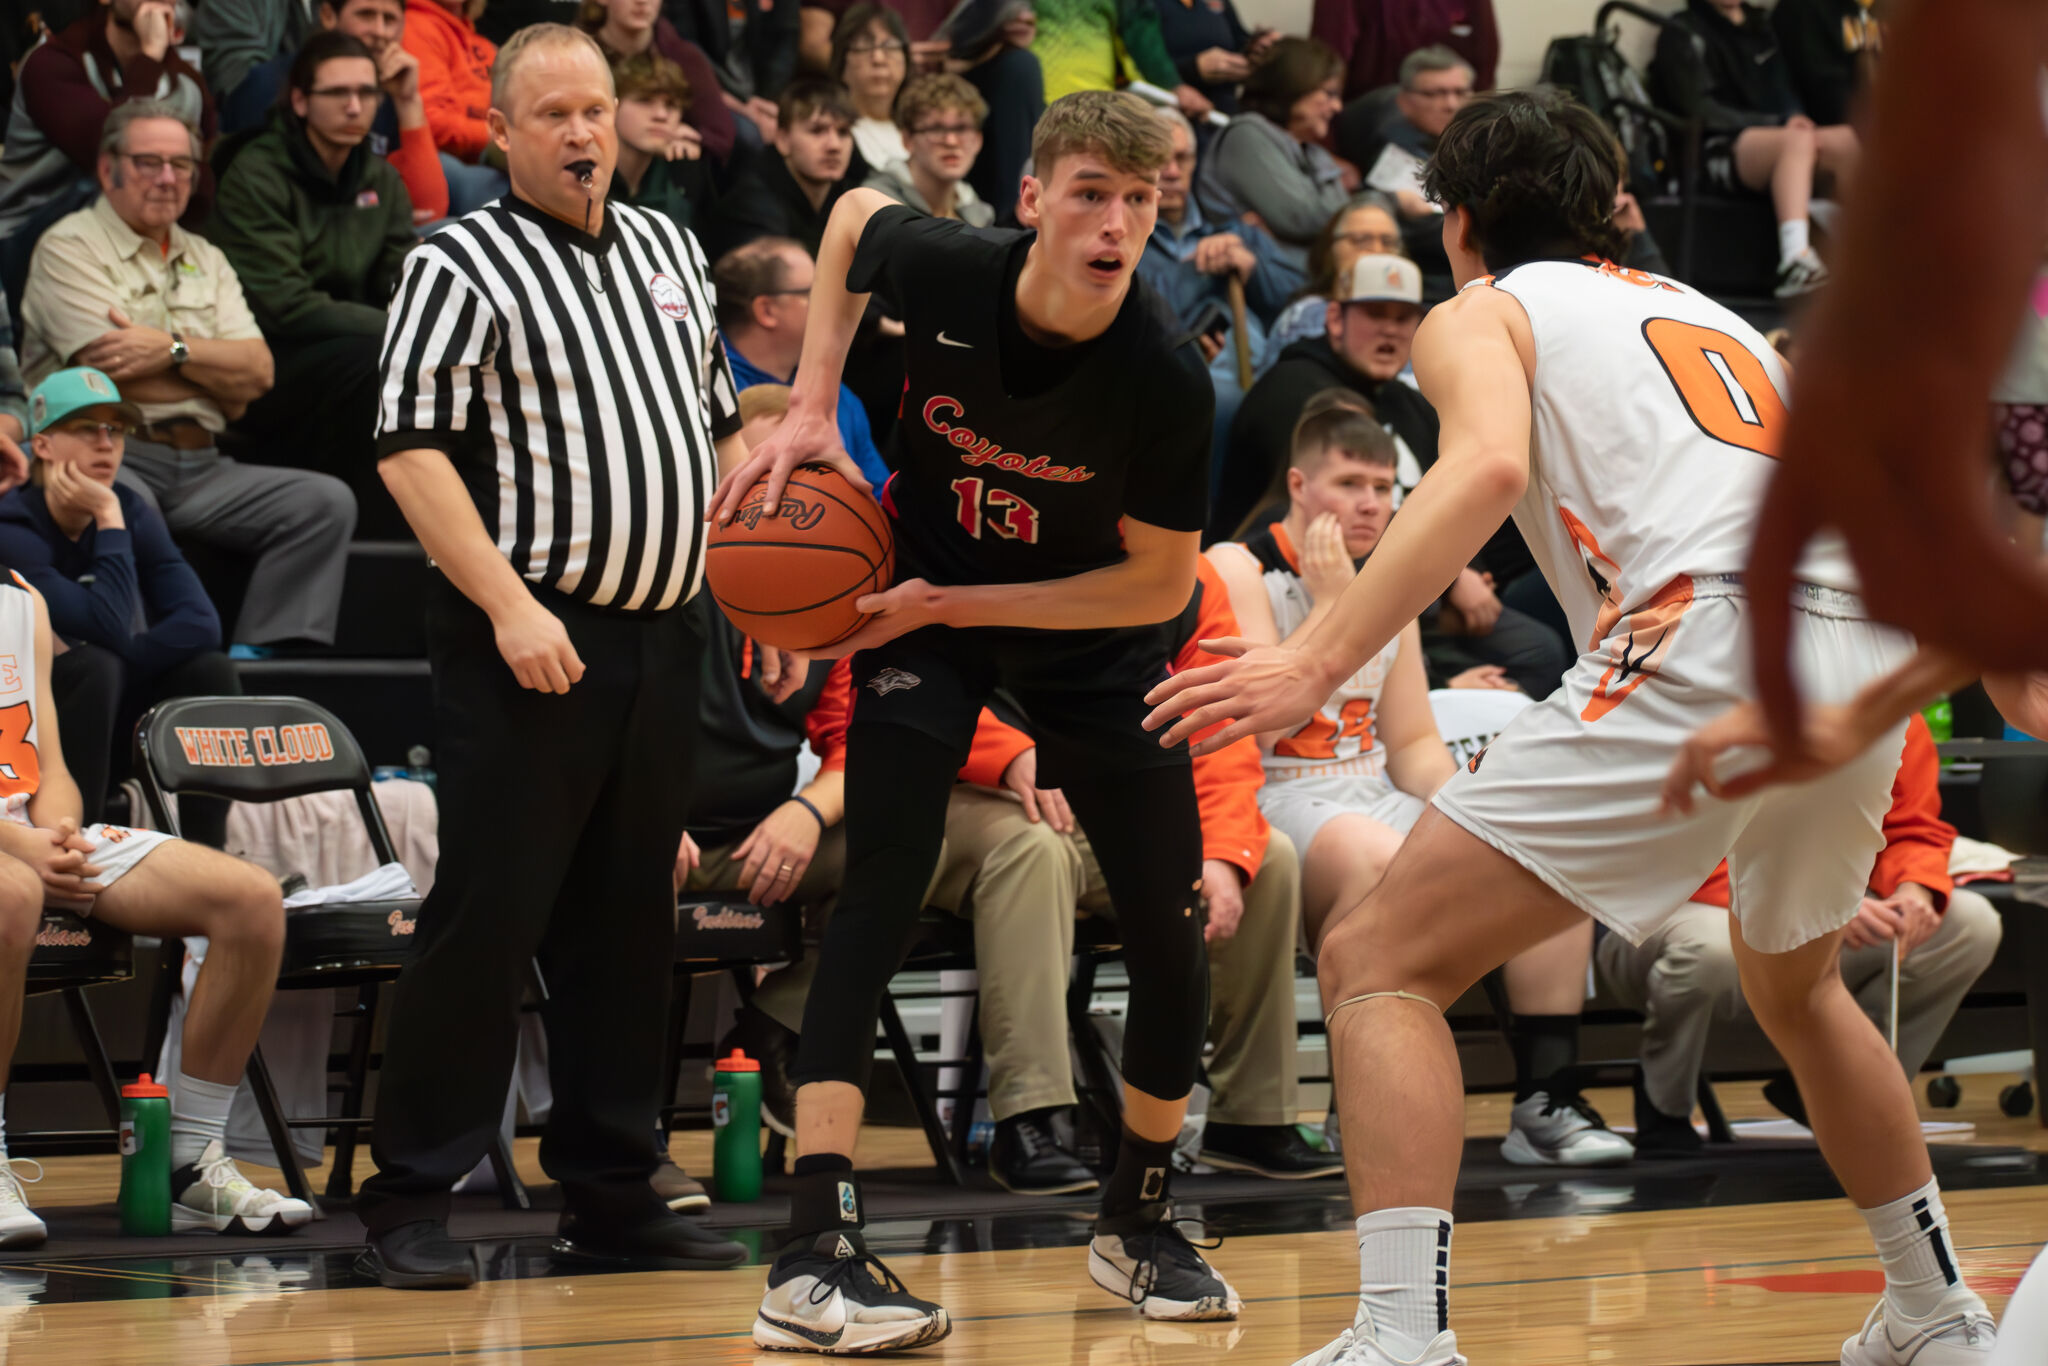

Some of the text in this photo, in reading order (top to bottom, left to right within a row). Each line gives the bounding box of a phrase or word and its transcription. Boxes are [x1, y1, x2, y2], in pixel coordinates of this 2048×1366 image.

[1640, 316, 1786, 461] 0
[923, 395, 1096, 482] Coyotes
[951, 477, 1039, 544] 13
[174, 723, 335, 766] WHITE CLOUD
